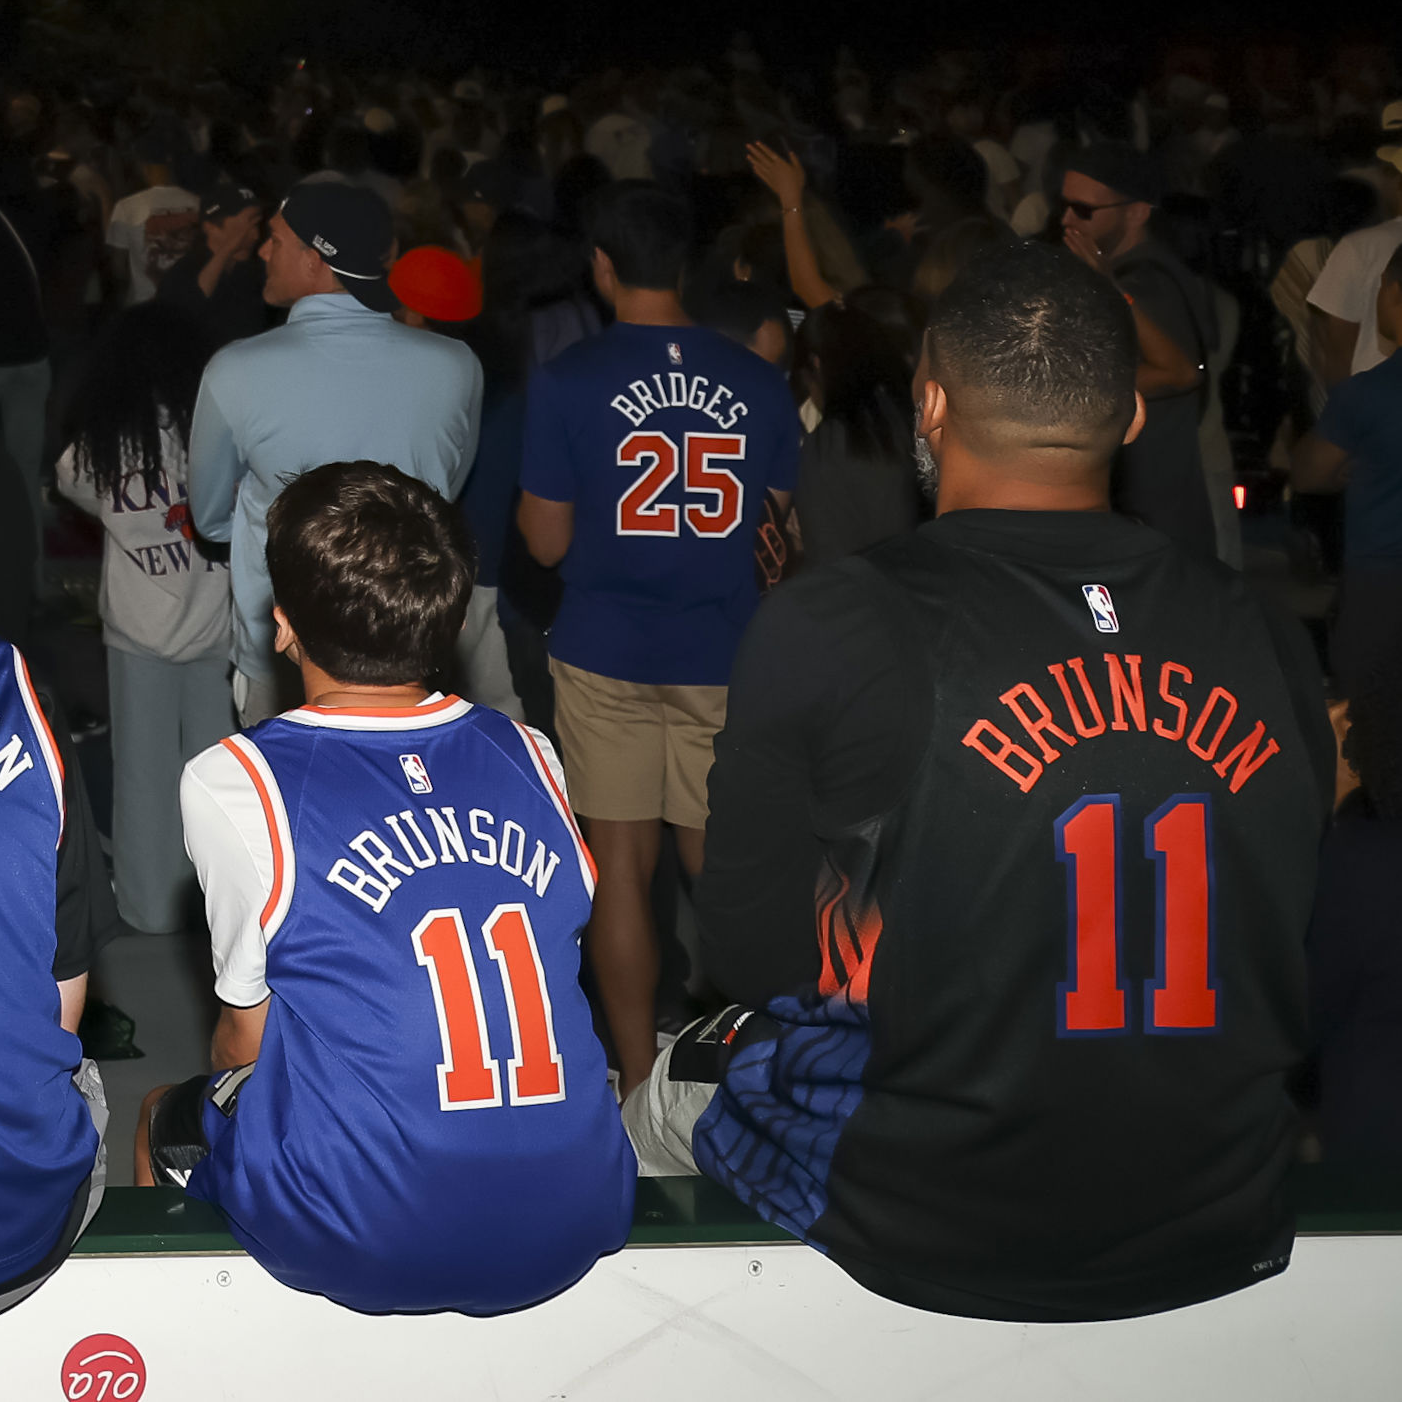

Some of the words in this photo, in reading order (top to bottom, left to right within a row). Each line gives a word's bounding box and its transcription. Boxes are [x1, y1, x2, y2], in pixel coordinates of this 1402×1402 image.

[610, 372, 749, 429] BRIDGES
[616, 431, 747, 539] 25
[961, 652, 1281, 795] BRUNSON
[326, 807, 562, 913] BRUNSON
[1053, 793, 1219, 1039] 11
[410, 902, 567, 1112] 11
